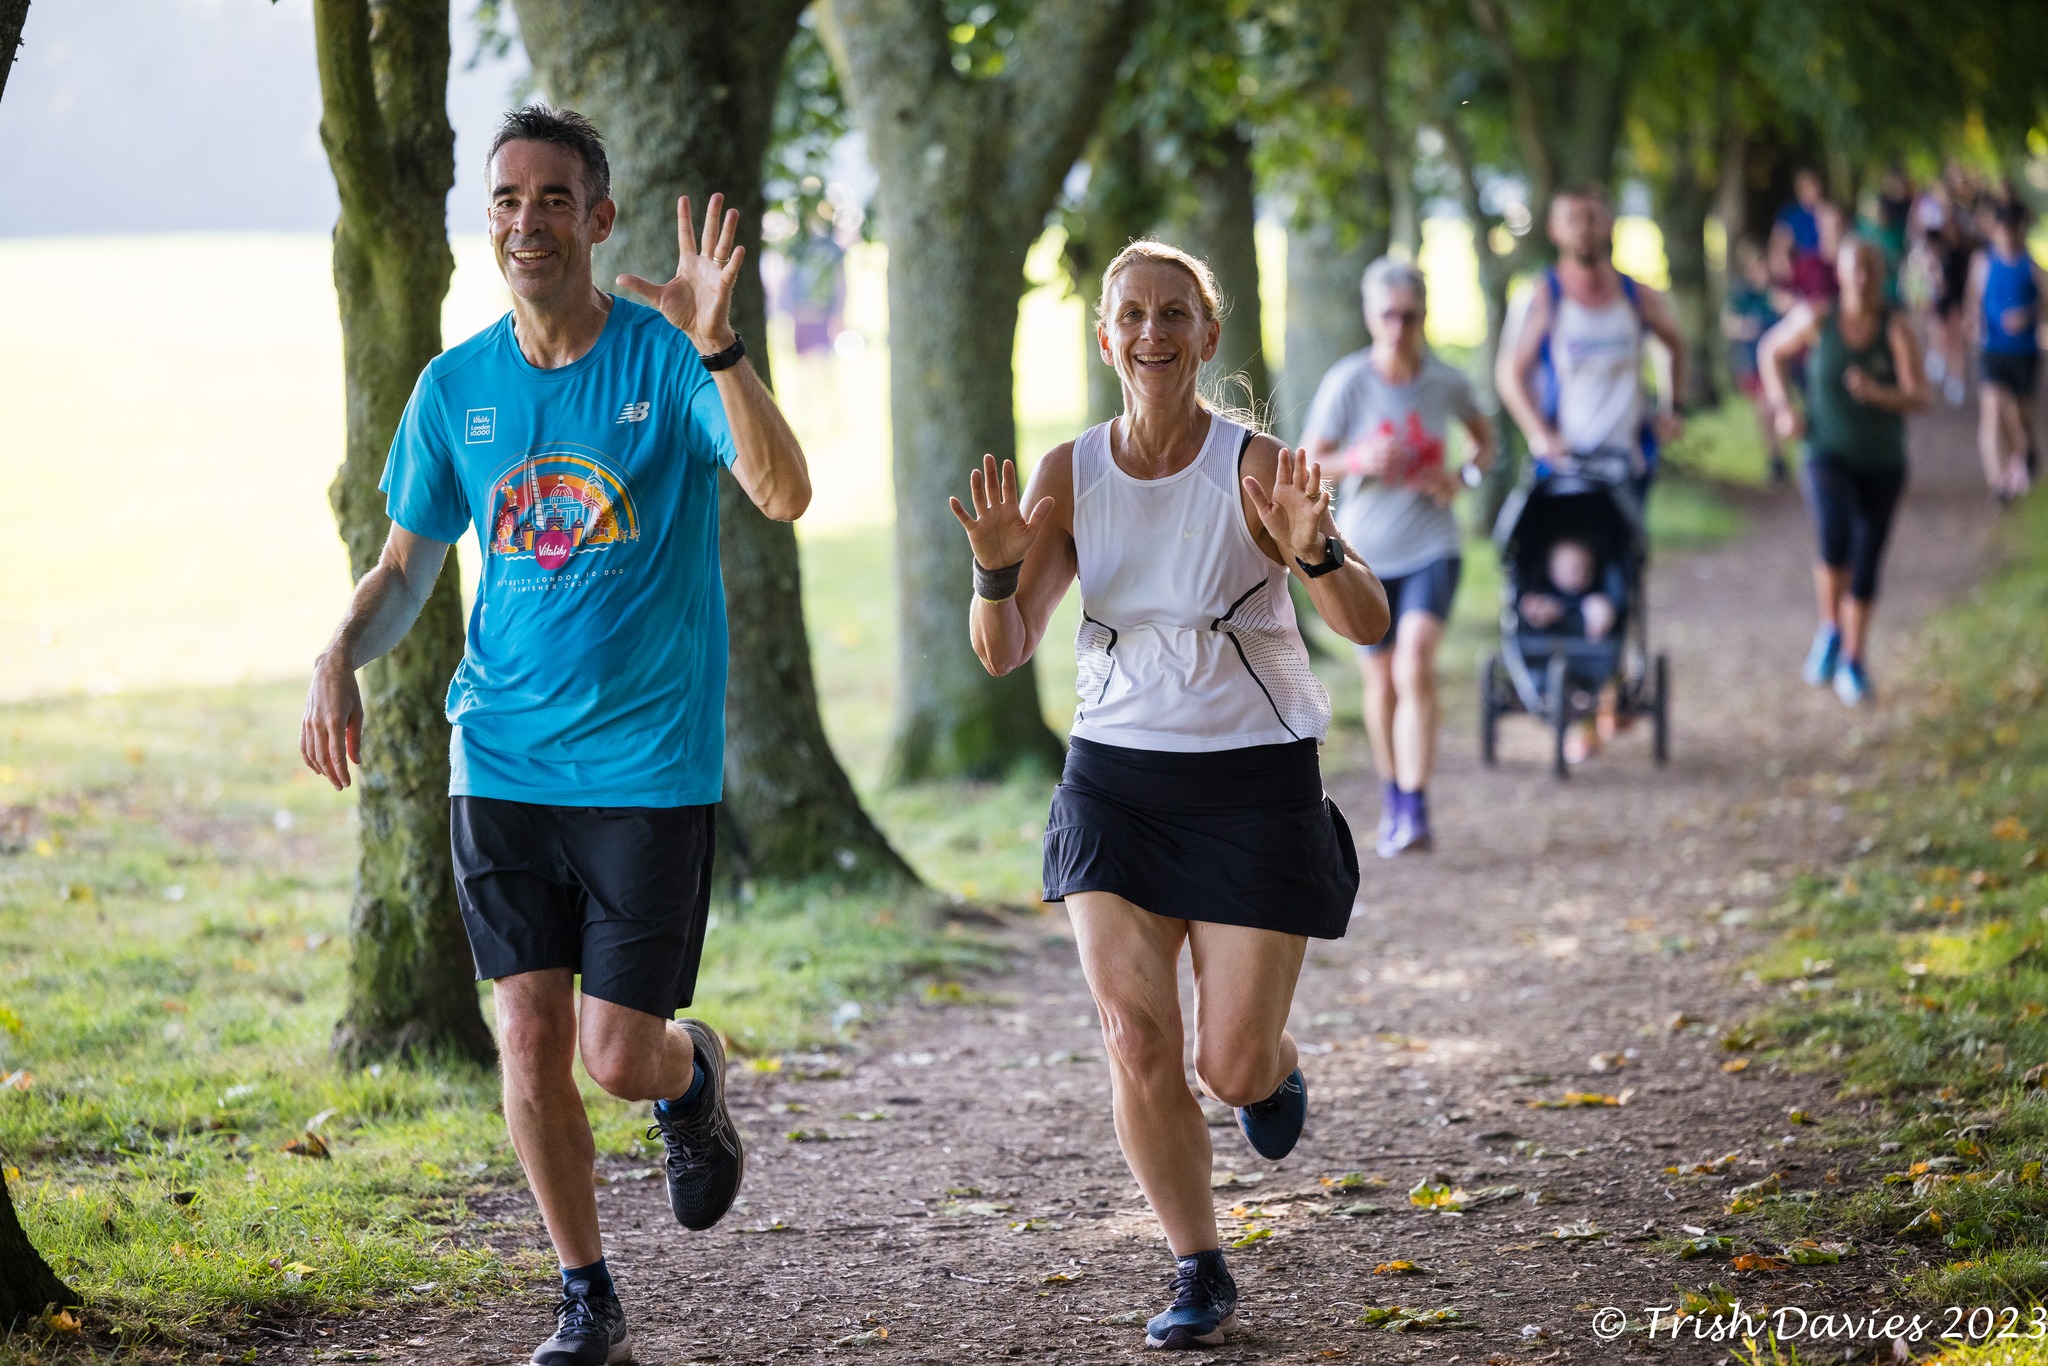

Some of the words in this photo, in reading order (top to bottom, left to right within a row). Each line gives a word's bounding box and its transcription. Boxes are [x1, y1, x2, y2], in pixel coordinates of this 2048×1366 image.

[538, 542, 568, 559] Vitality
[536, 573, 579, 583] LONDON
[513, 584, 557, 593] FINISHER
